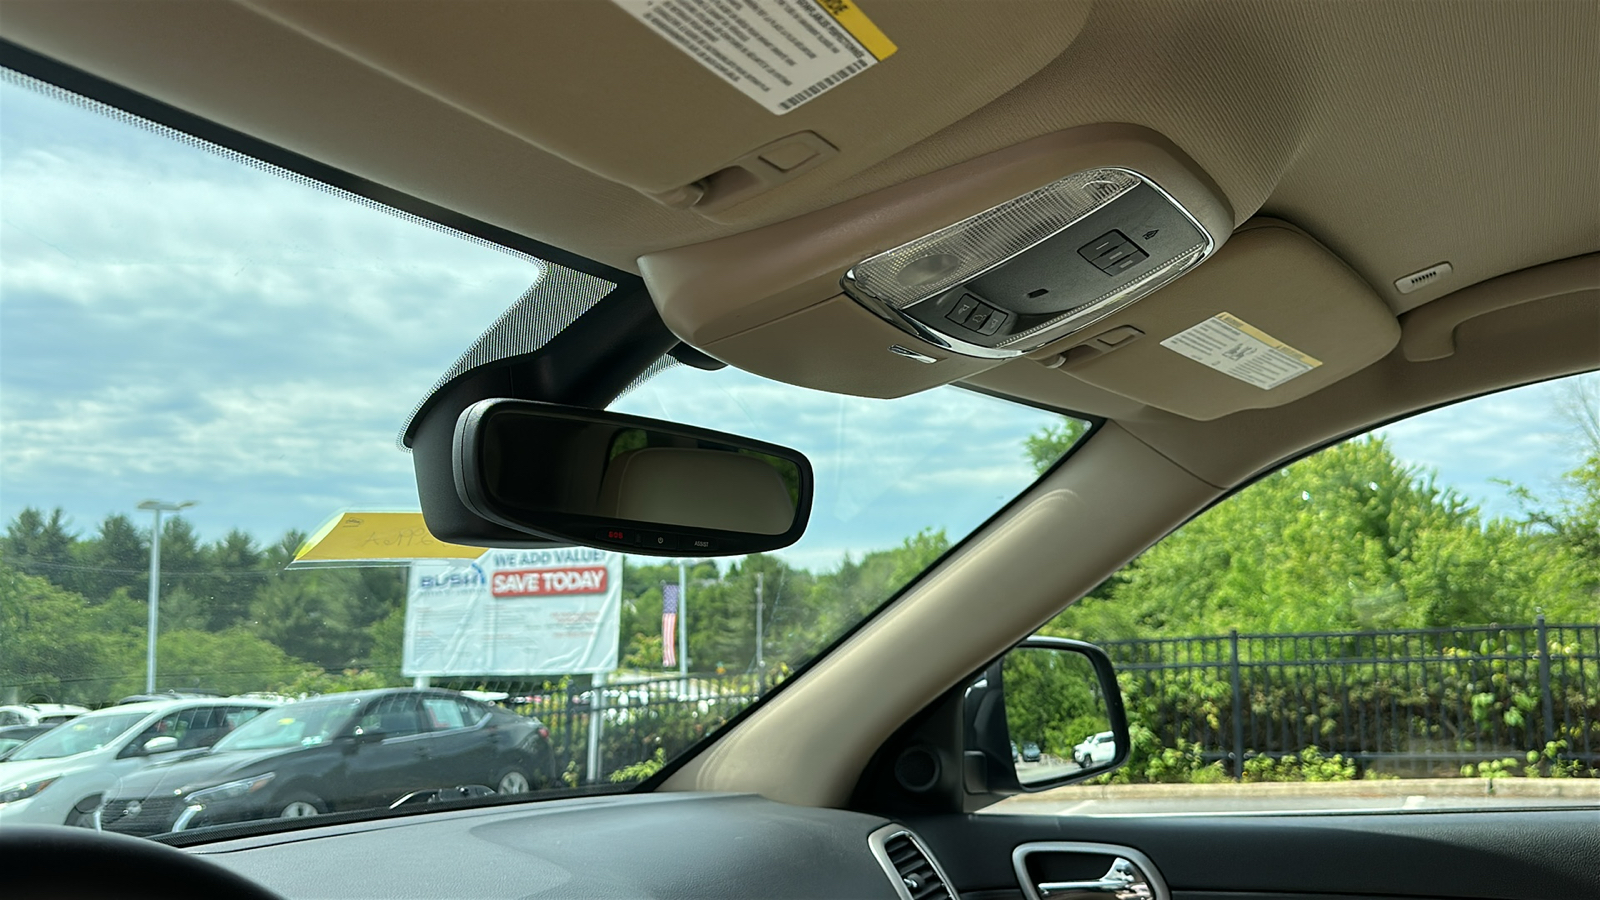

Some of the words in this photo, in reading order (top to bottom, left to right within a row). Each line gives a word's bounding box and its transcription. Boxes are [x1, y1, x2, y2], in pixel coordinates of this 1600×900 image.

[694, 540, 710, 548] ASSIST
[493, 552, 517, 567] WE
[519, 551, 551, 565] ADD
[421, 573, 479, 588] BUSH
[493, 573, 540, 593] SAVE
[542, 570, 605, 590] TODAY
